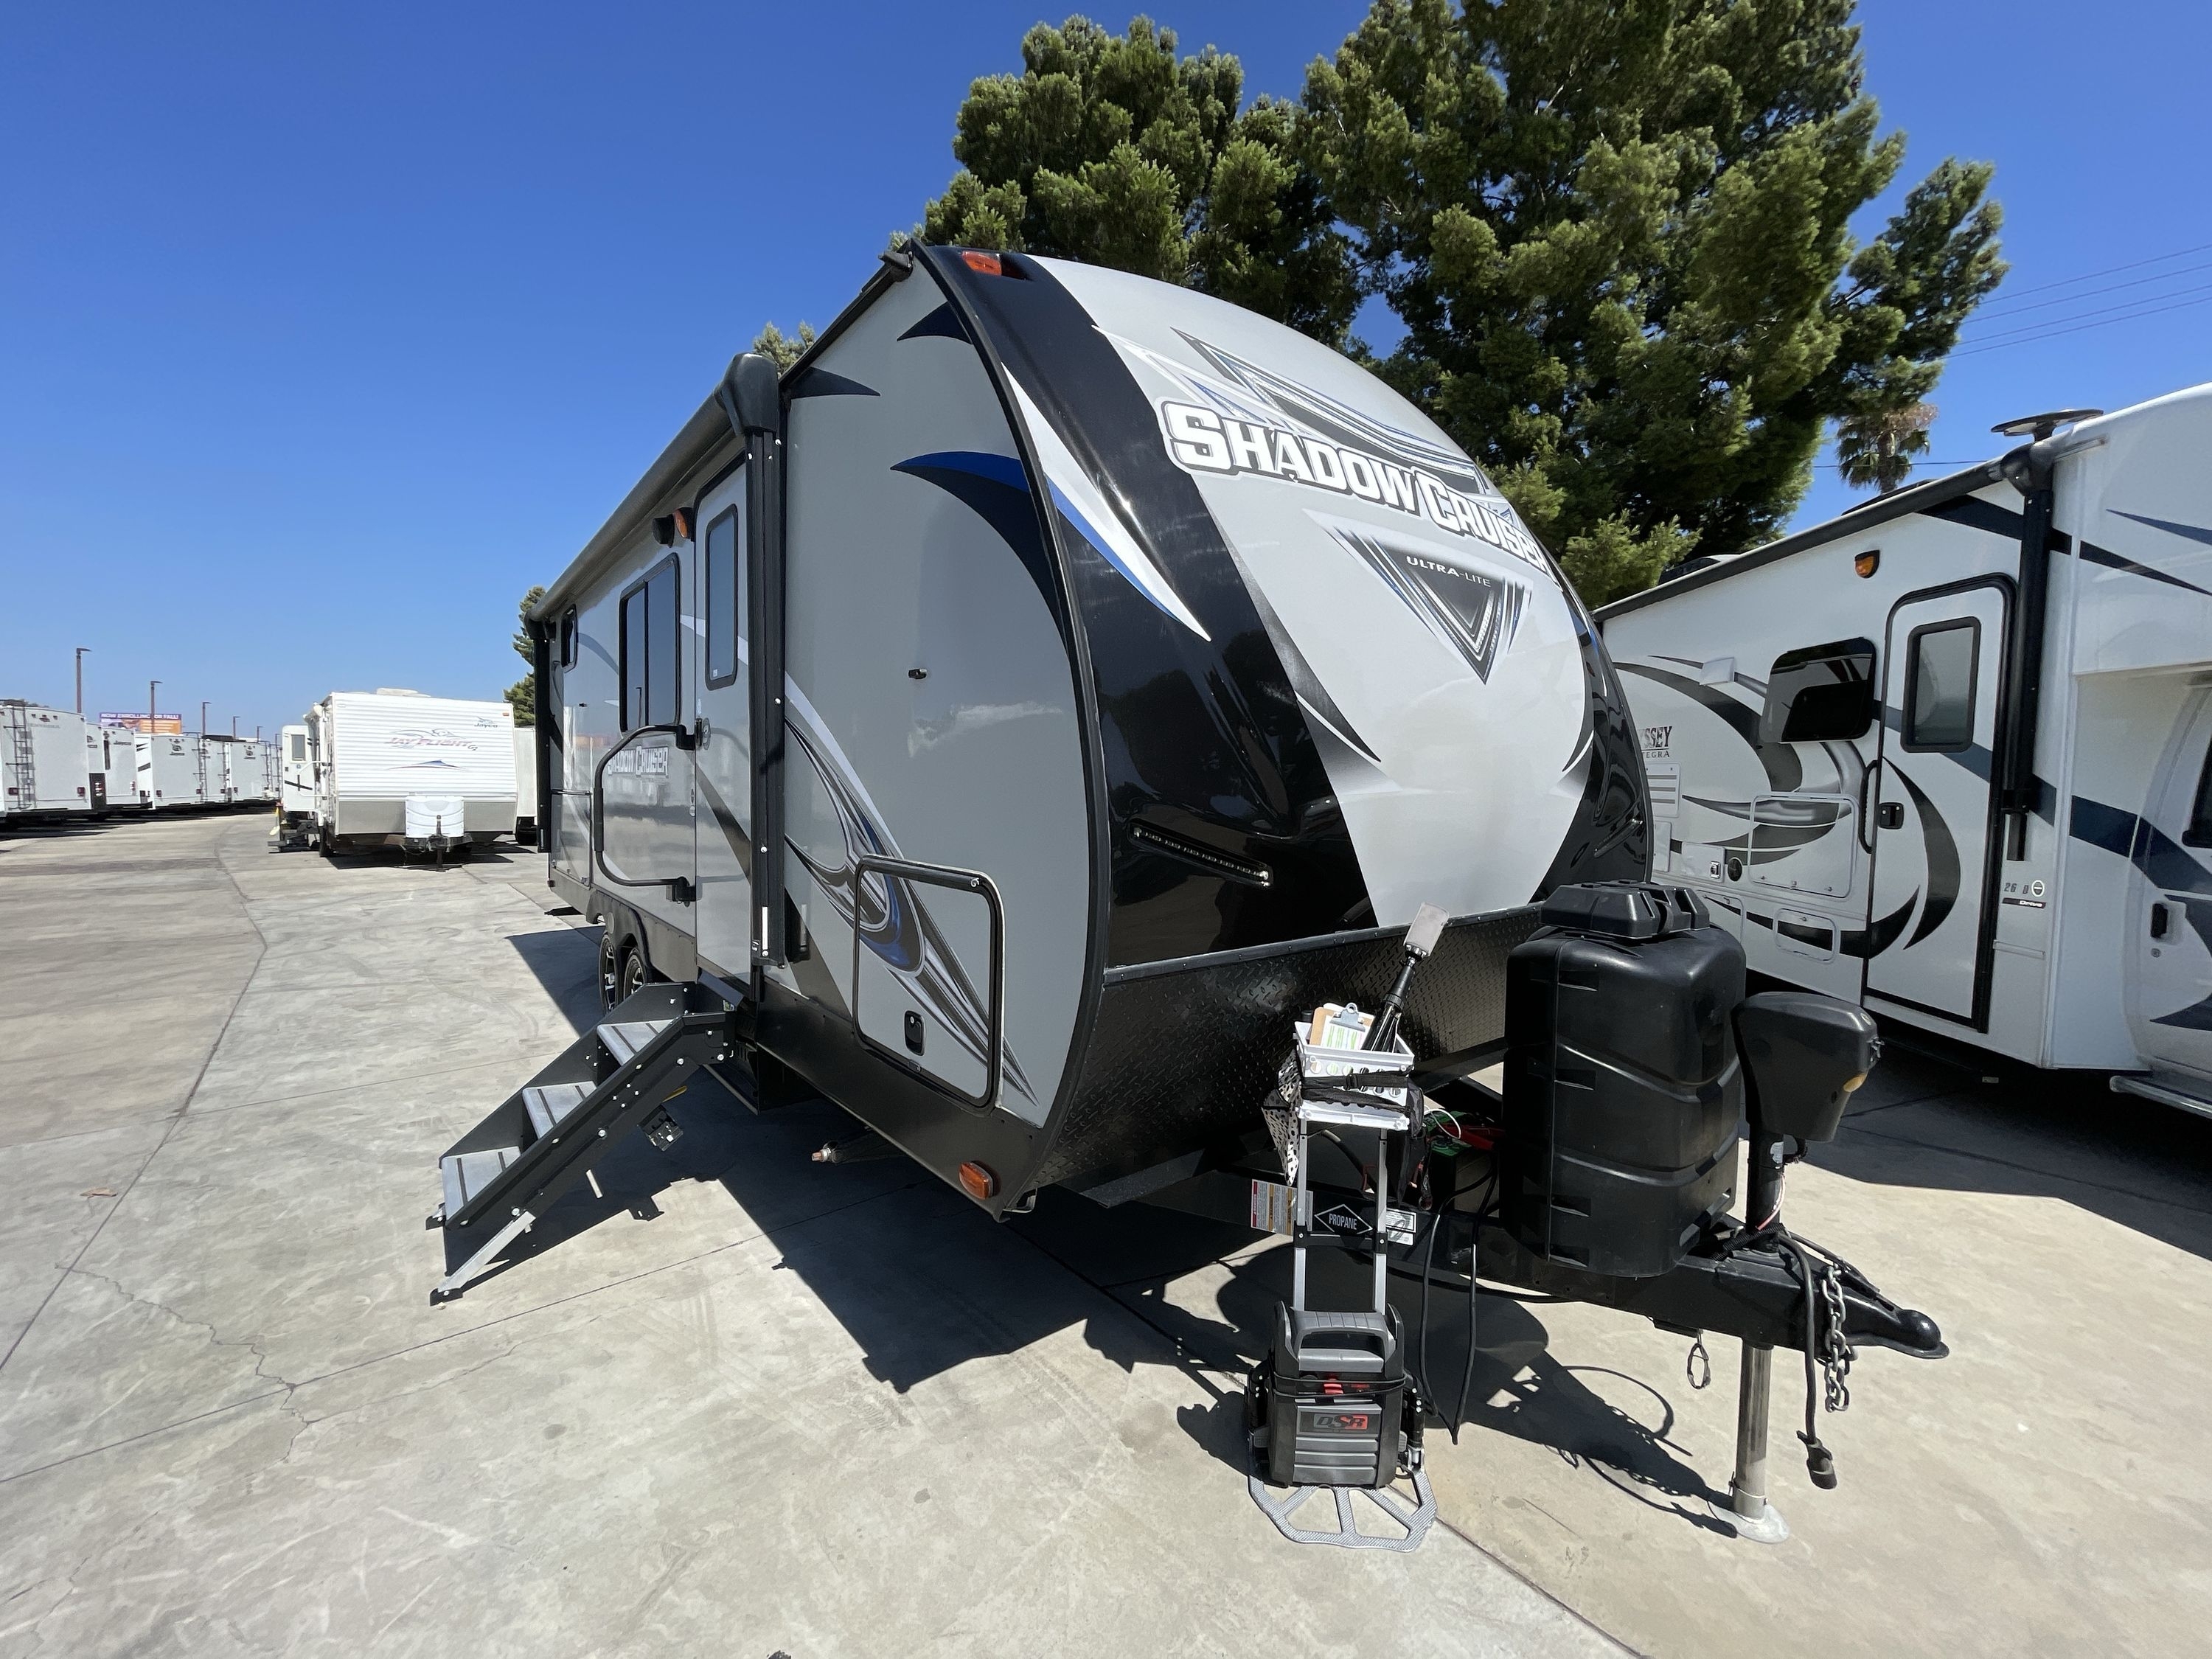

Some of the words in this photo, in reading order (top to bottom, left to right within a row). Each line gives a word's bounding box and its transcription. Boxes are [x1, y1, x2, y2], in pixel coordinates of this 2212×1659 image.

[1162, 401, 1420, 517] SHADOW
[1414, 470, 1557, 586] CRUISER
[1405, 554, 1492, 588] ULTRA-LITE
[636, 745, 669, 778] CRUISER
[2003, 882, 2017, 893] 26
[1329, 1213, 1357, 1231] PROPANE
[1316, 1414, 1366, 1428] DSR
